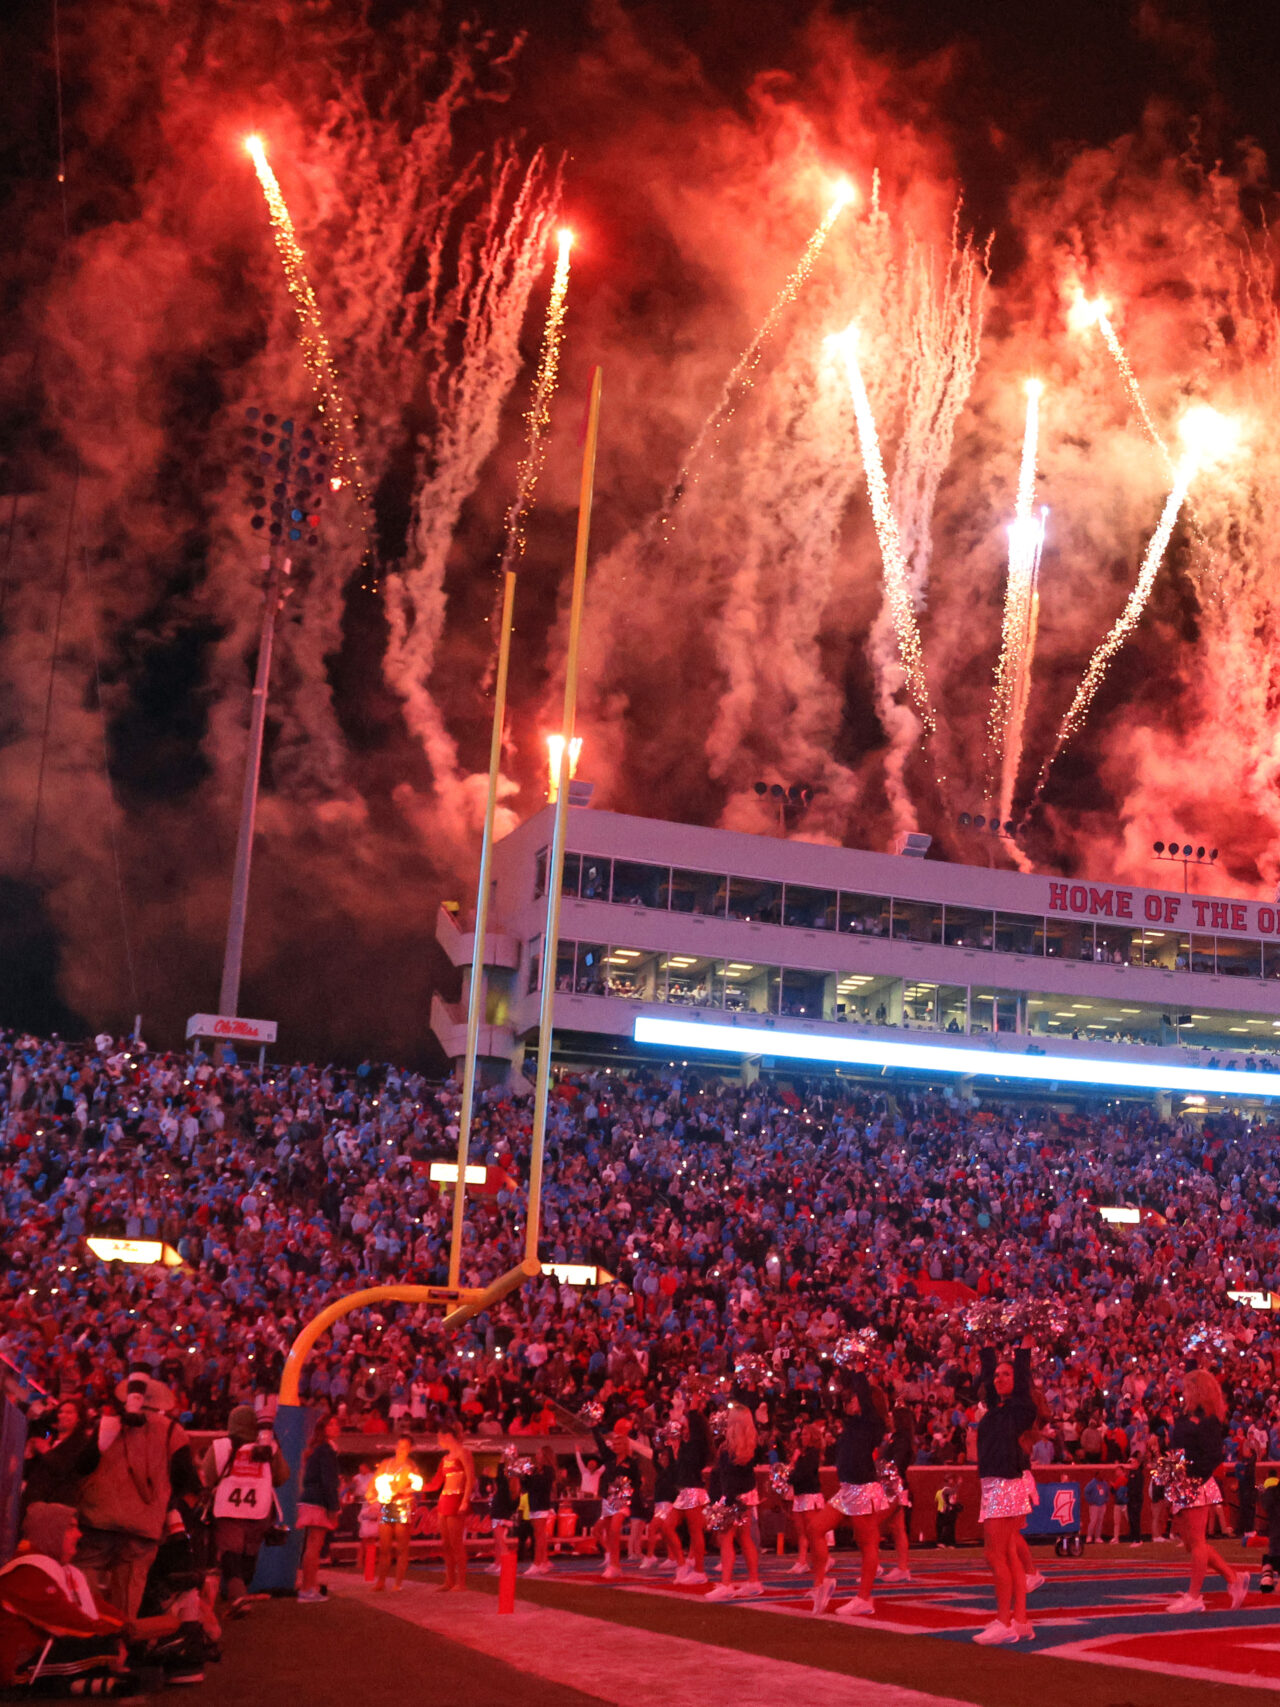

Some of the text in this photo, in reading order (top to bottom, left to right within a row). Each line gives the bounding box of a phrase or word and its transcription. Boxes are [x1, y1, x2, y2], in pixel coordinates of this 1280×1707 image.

[1048, 882, 1133, 919] HOME
[1144, 894, 1181, 923] OF
[1191, 901, 1248, 931] THE
[228, 1487, 257, 1508] 44
